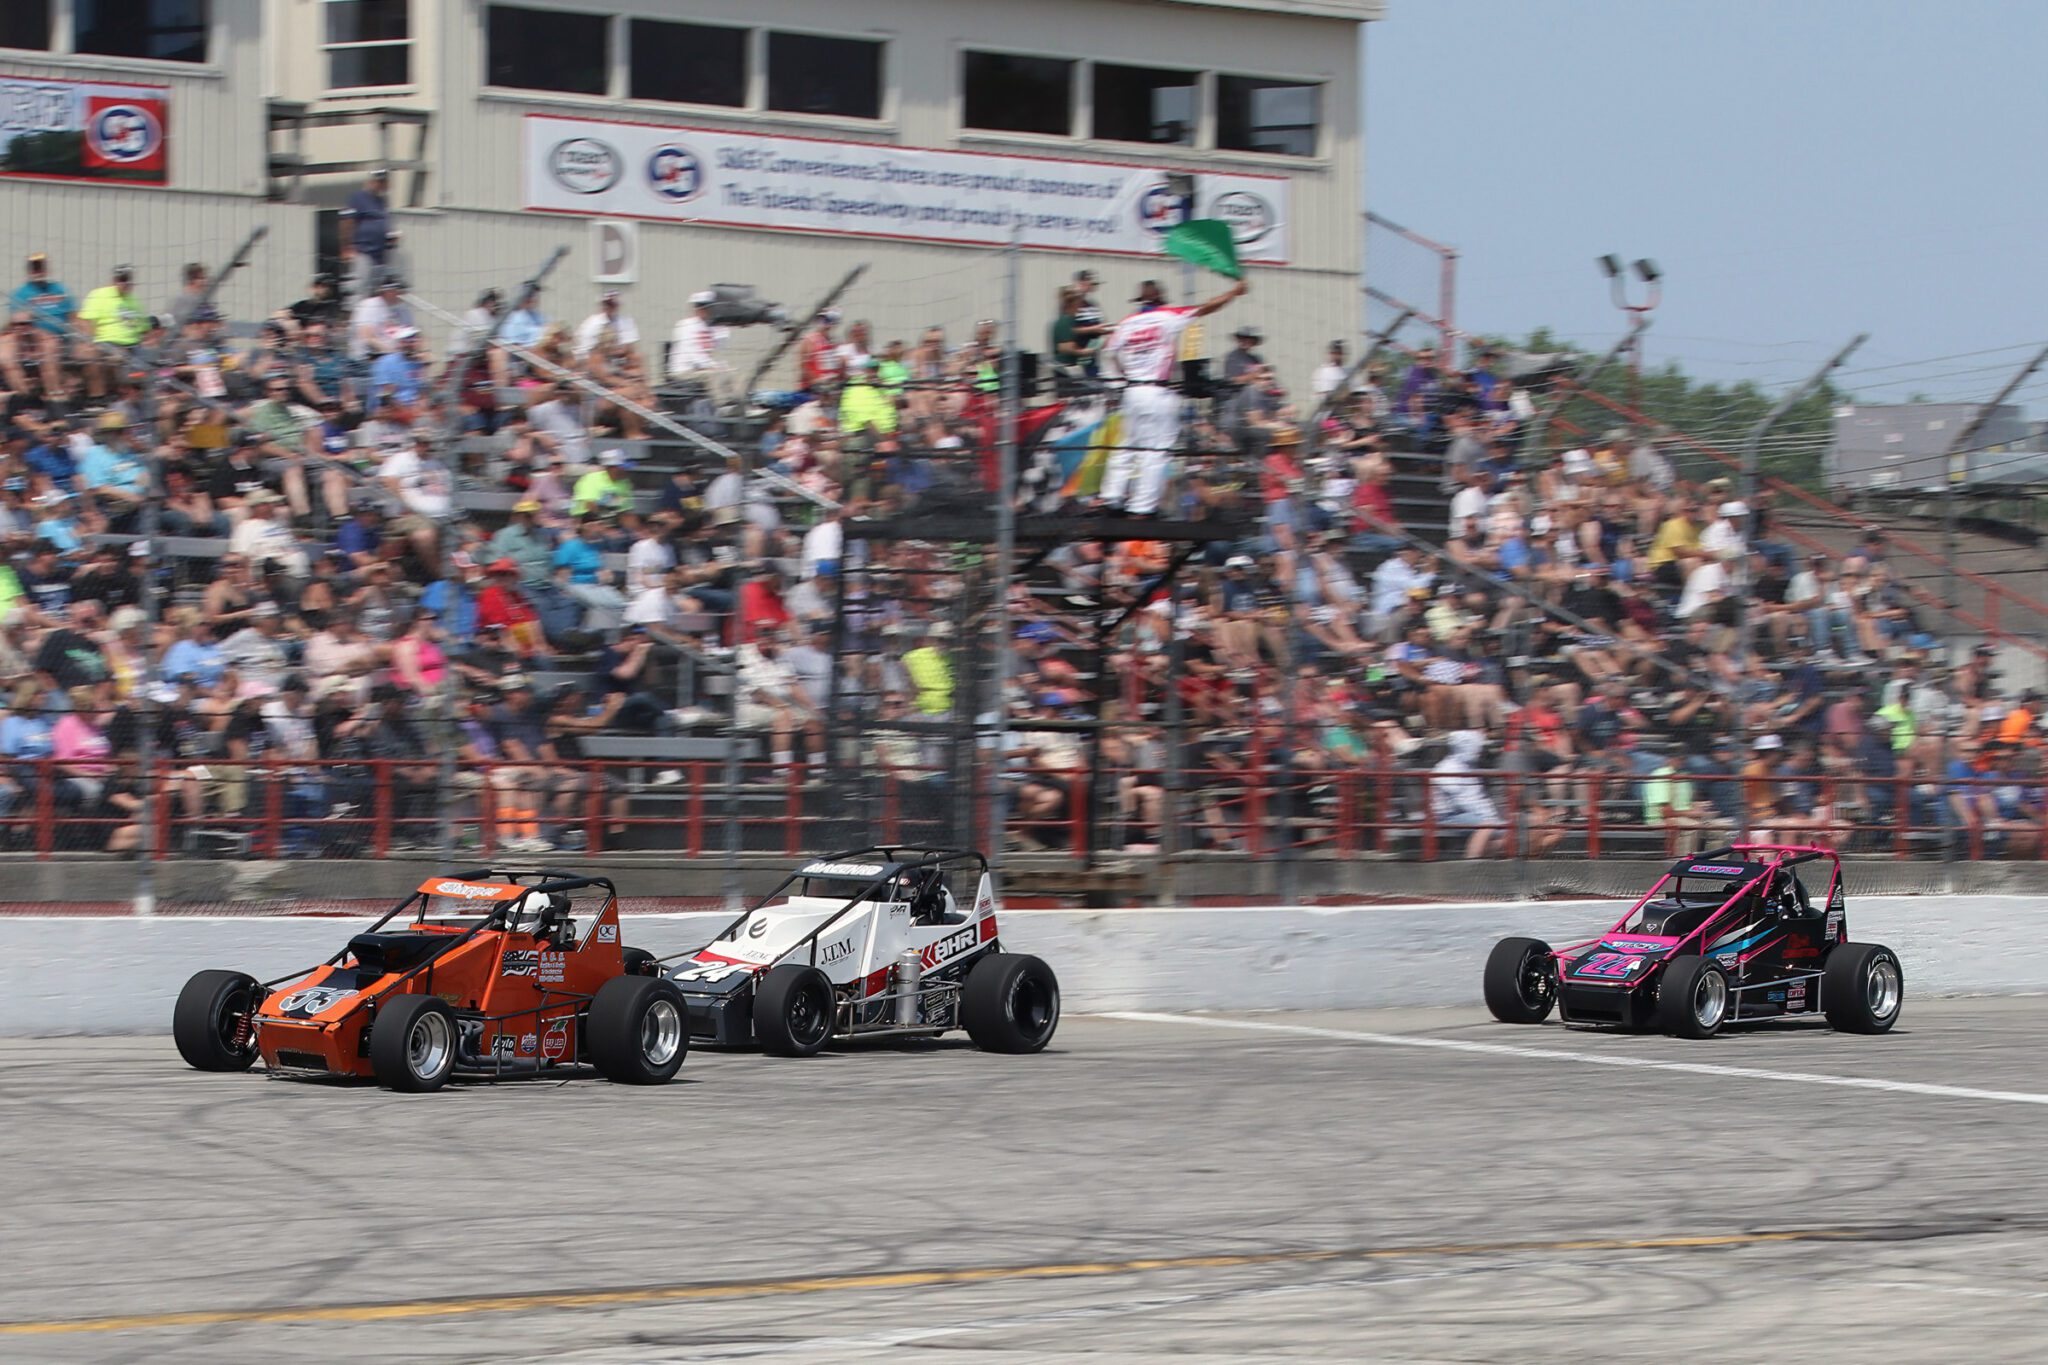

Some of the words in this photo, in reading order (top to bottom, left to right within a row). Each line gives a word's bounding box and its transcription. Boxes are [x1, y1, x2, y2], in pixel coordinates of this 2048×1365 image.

[598, 224, 628, 276] D
[600, 925, 616, 937] QC
[673, 961, 753, 983] 24
[279, 986, 360, 1014] 53
